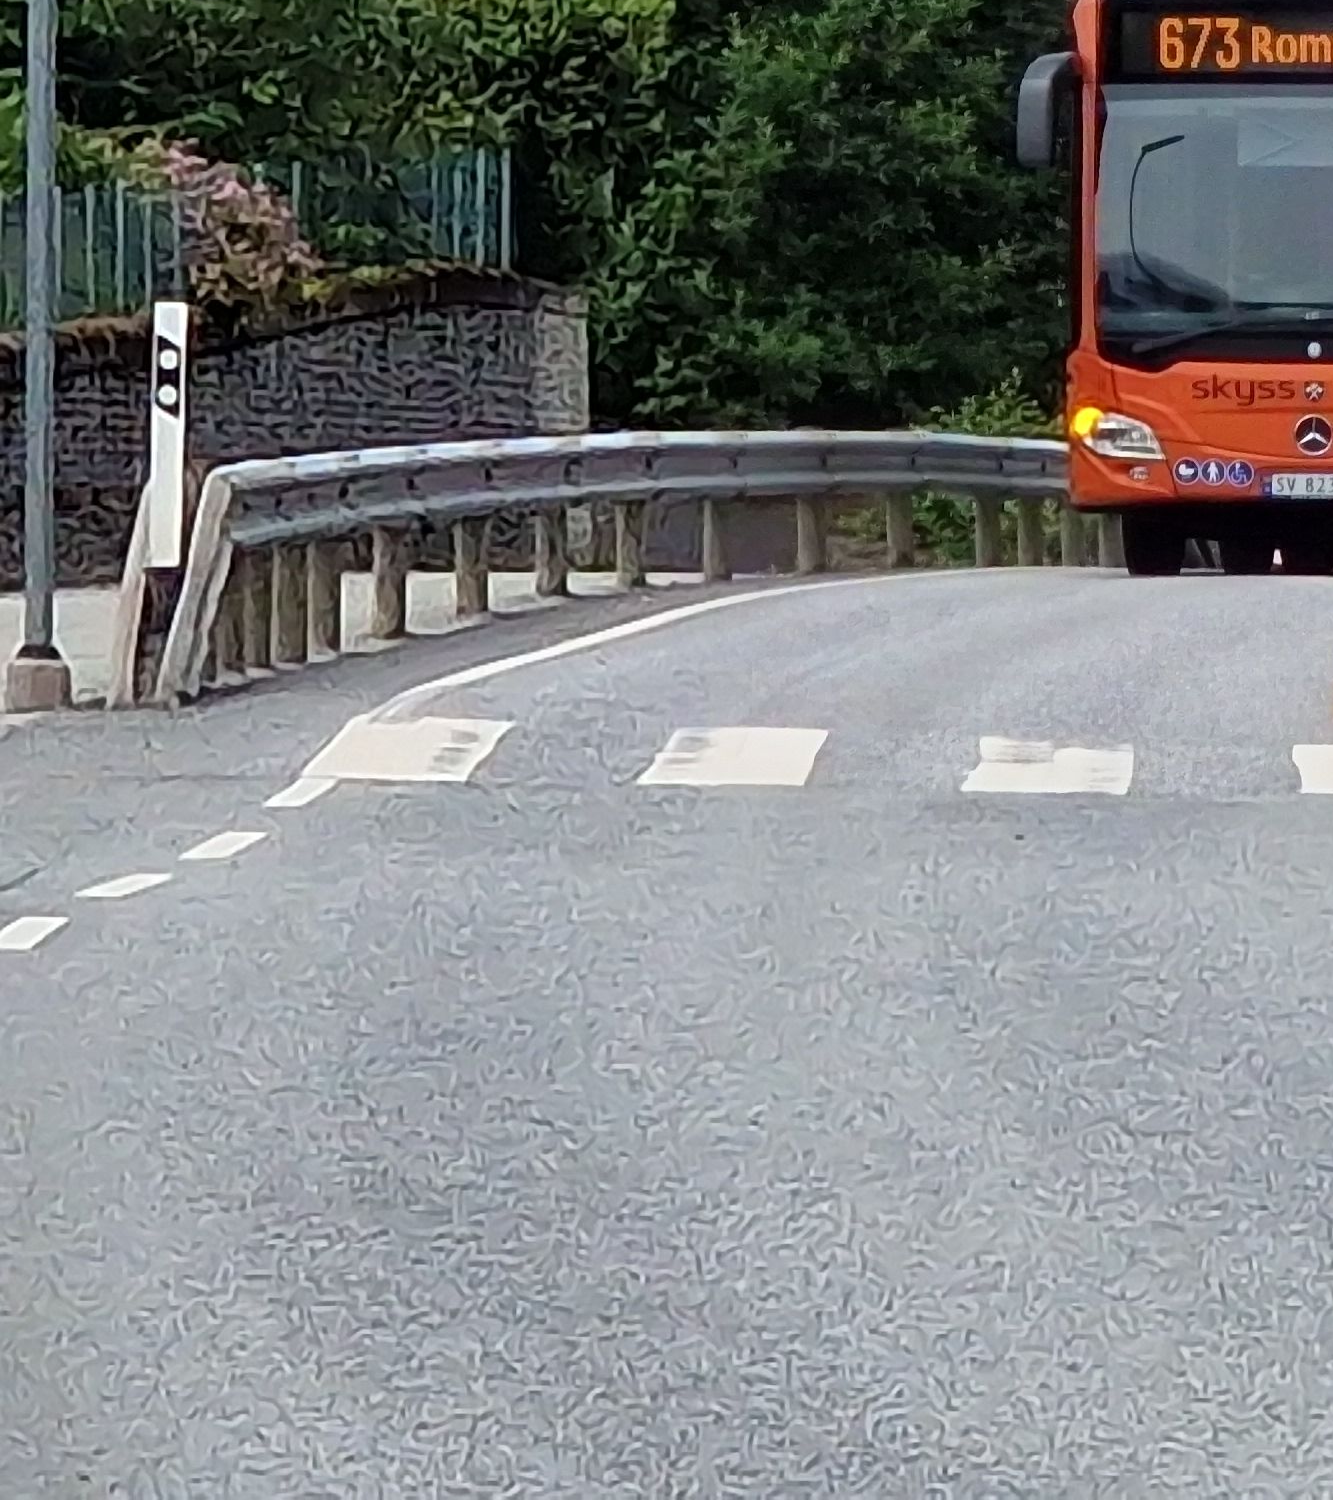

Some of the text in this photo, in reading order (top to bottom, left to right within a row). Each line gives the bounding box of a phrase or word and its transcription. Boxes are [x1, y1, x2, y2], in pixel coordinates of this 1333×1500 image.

[1158, 16, 1241, 69] 673
[1191, 374, 1296, 406] skyss
[1276, 477, 1297, 493] SV
